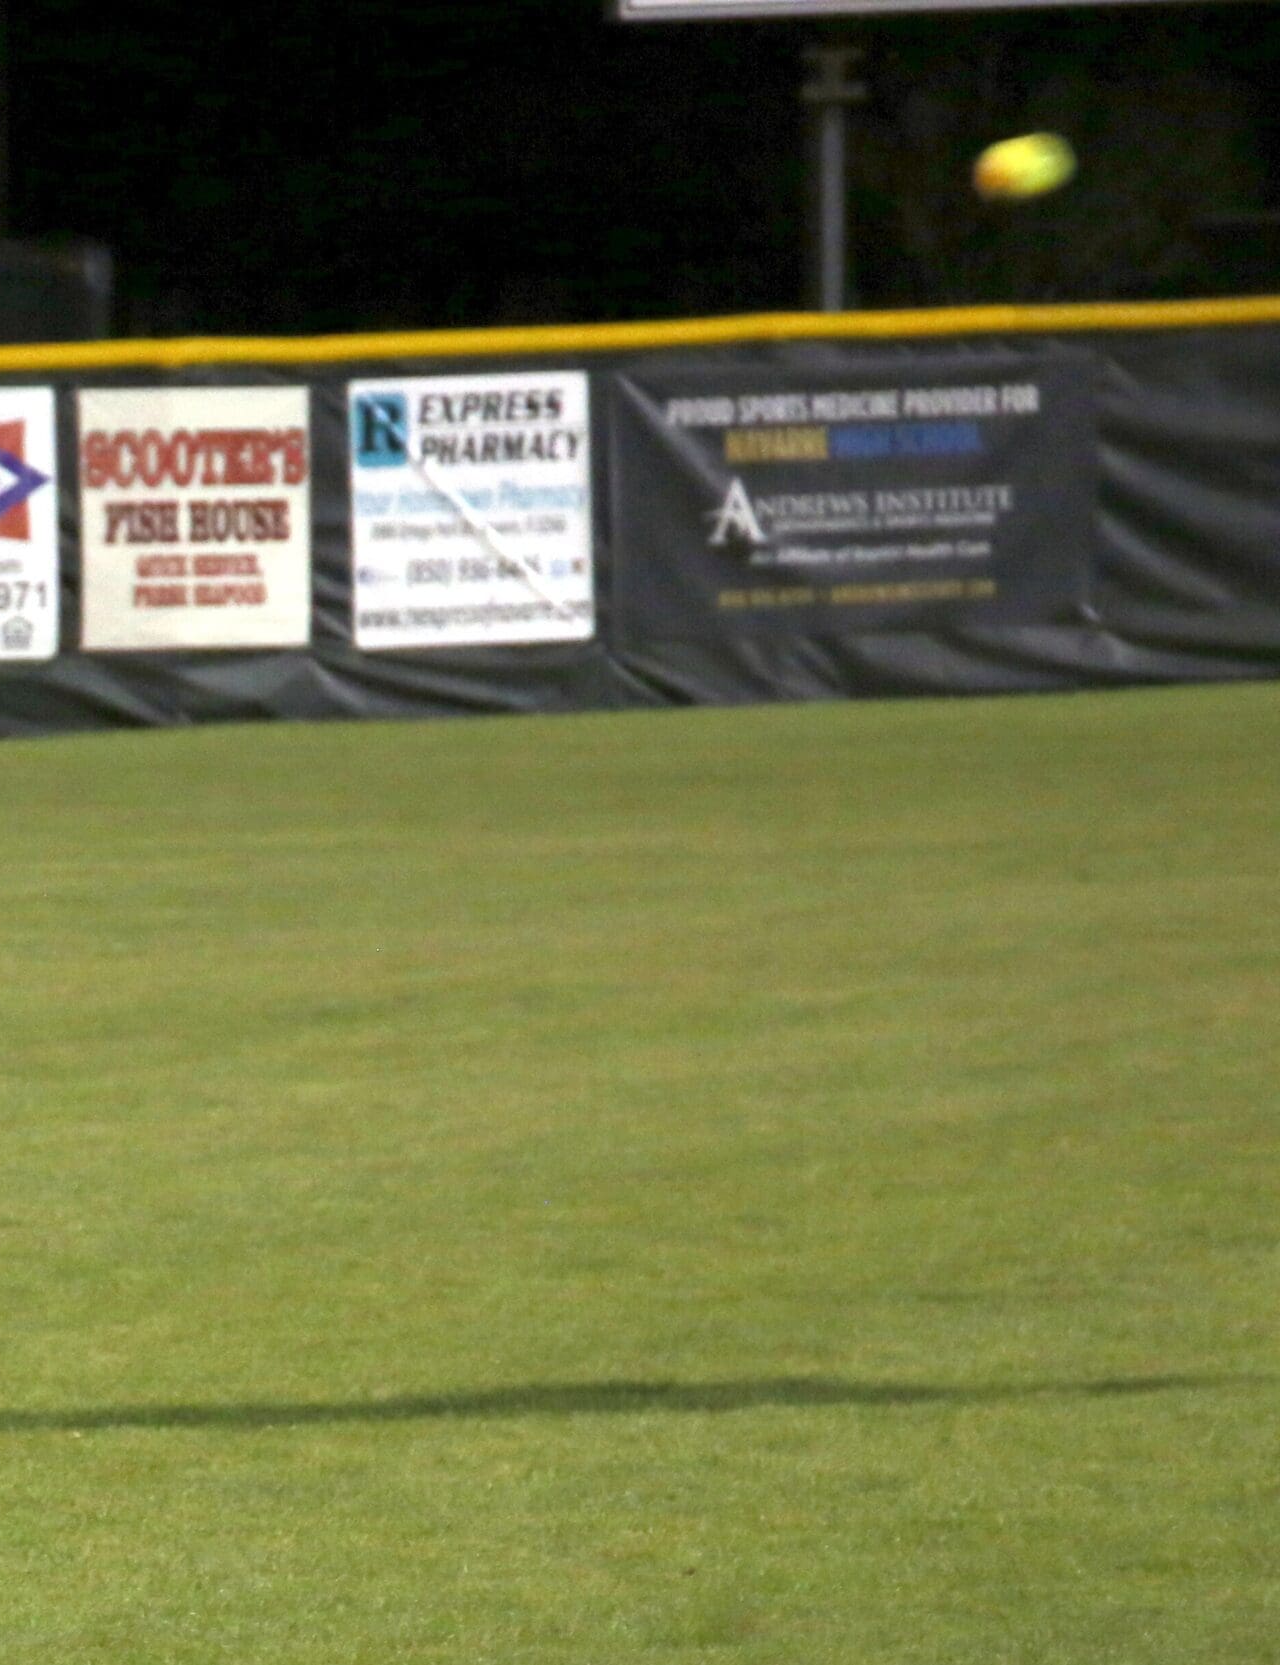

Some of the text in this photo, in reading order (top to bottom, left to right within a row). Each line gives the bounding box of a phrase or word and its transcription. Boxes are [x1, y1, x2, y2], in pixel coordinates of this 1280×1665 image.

[419, 390, 563, 424] EXPRESS
[420, 429, 584, 464] PHARMACY
[876, 484, 1014, 514] INSTITUTE
[104, 499, 291, 544] FISH HOUSE
